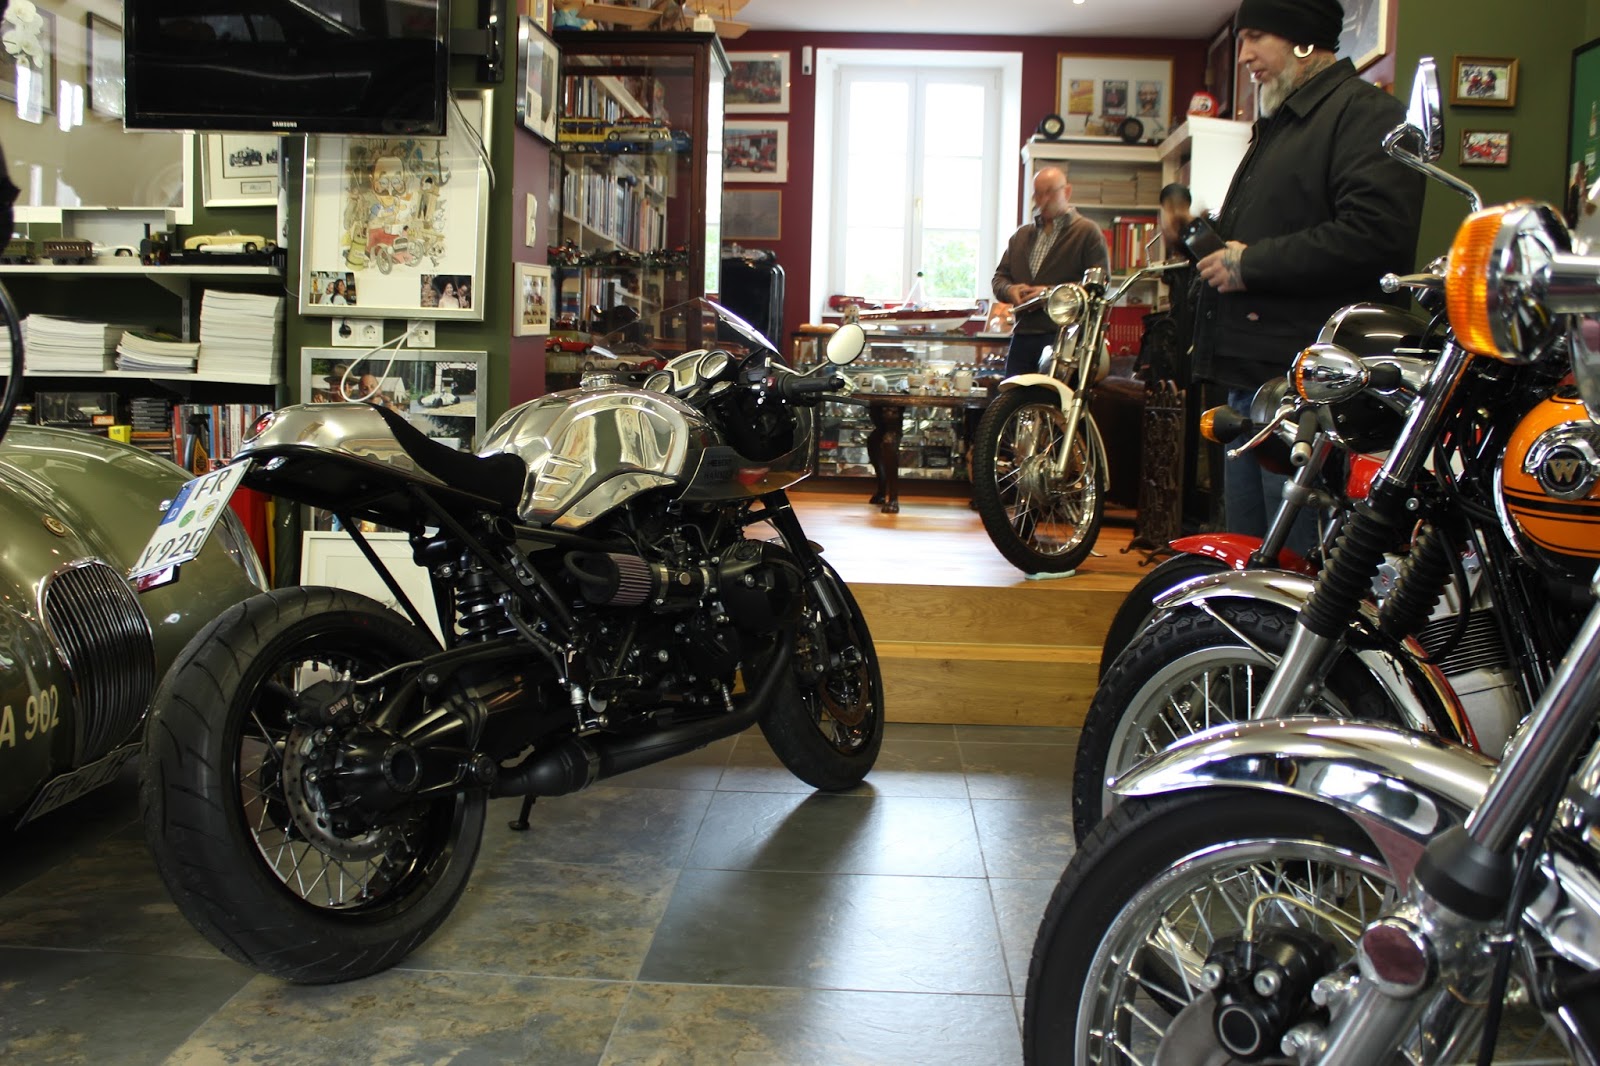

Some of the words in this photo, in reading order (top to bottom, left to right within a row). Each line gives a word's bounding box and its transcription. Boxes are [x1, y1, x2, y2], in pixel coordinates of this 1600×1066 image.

[194, 468, 231, 501] FR
[1548, 459, 1580, 482] W
[25, 684, 59, 741] 902
[330, 697, 349, 715] BMW
